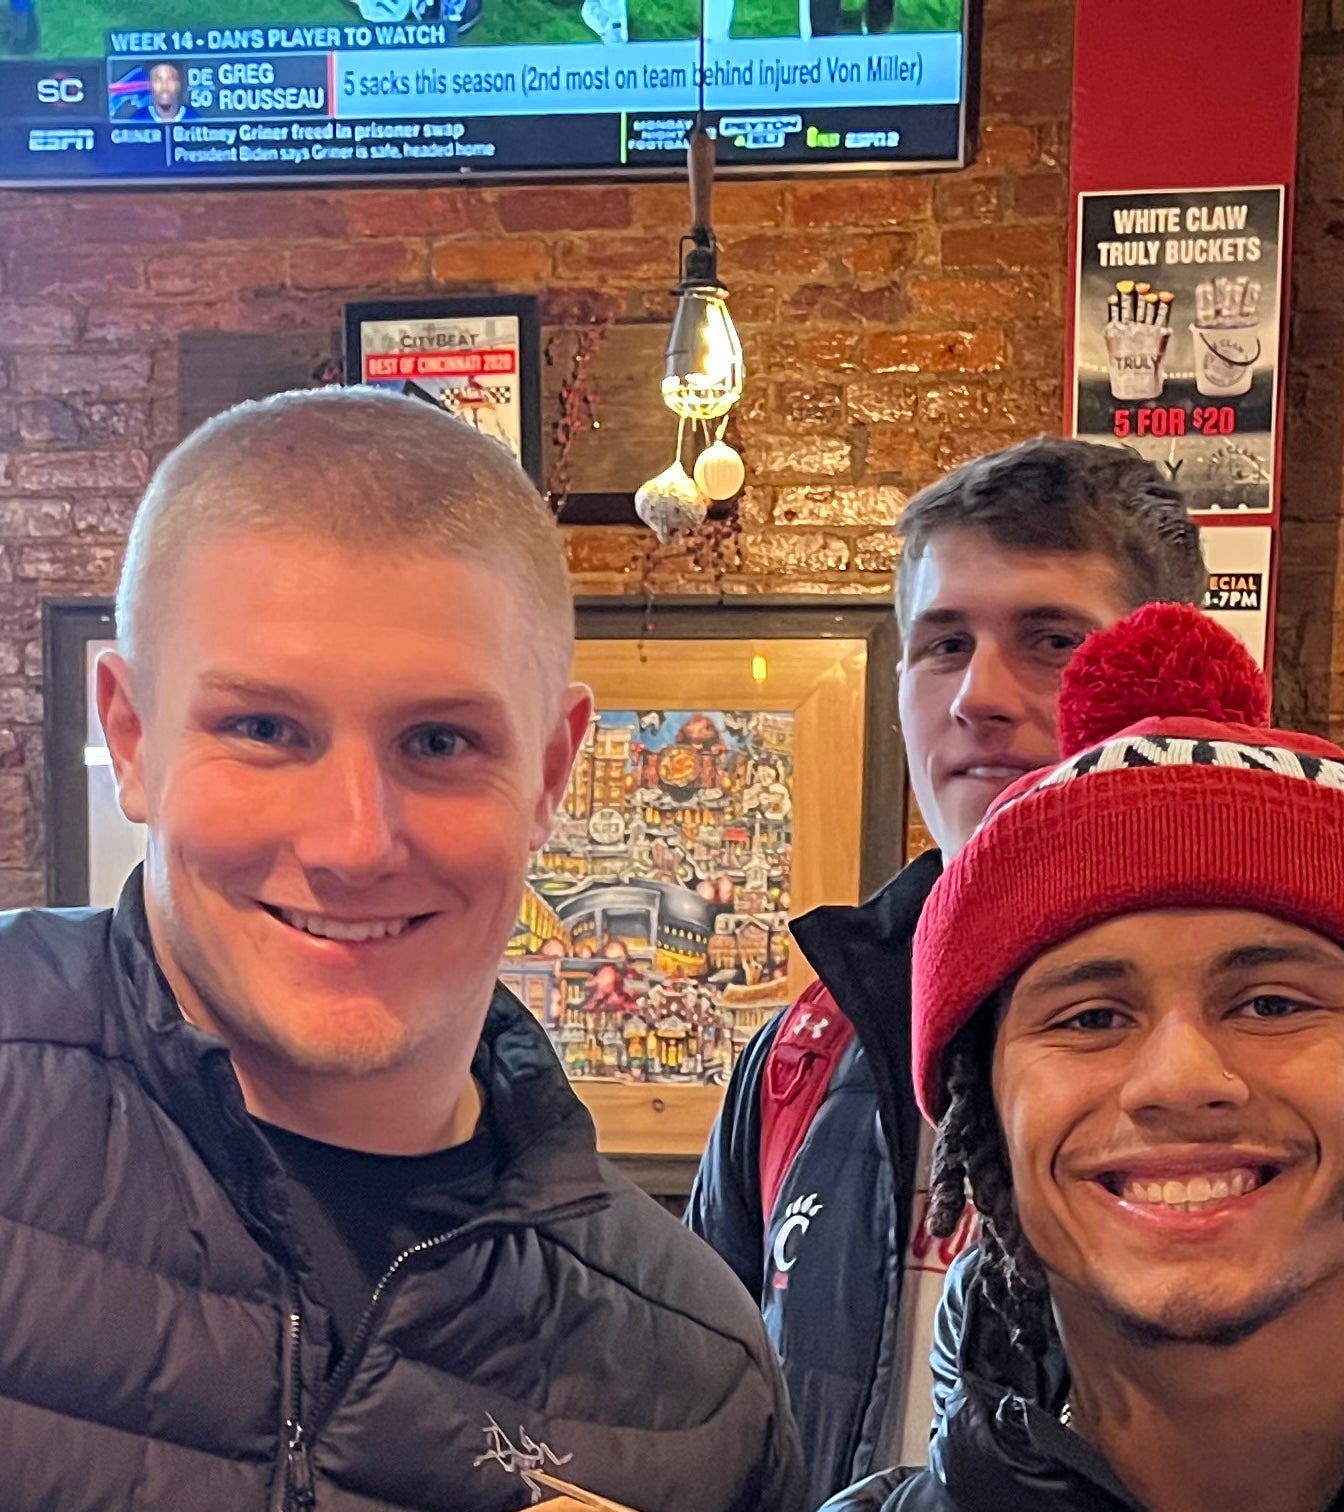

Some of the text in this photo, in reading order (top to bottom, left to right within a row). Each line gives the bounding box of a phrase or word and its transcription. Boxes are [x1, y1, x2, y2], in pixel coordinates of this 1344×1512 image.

[111, 32, 168, 51] WEEK
[172, 32, 193, 50] 14
[268, 27, 341, 48] PLAYER
[344, 27, 371, 46] TO
[375, 25, 446, 45] WATCH
[188, 68, 213, 86] DE
[218, 63, 274, 85] GREG
[344, 52, 923, 97] 5 sacks this season (2nd most on team behind injured Von Miller)
[37, 78, 84, 103] SC
[190, 91, 212, 107] 50
[220, 88, 324, 110] ROUSSEAU
[29, 128, 94, 150] ESPN
[239, 124, 288, 141] Griner
[292, 123, 333, 140] freed
[336, 123, 352, 139] in
[355, 122, 420, 141] prisoner
[423, 123, 465, 139] swap
[175, 147, 238, 162] President
[239, 145, 278, 161] Biden
[312, 144, 354, 160] Griner
[1113, 205, 1248, 234] WHITE CLAW
[1097, 236, 1261, 267] TRULY BUCKETS
[369, 357, 398, 376] BEST
[400, 356, 415, 374] OF
[1115, 355, 1161, 371] TRULY
[1113, 406, 1236, 438] 5 FOR $20
[1210, 577, 1257, 590] ECIAL
